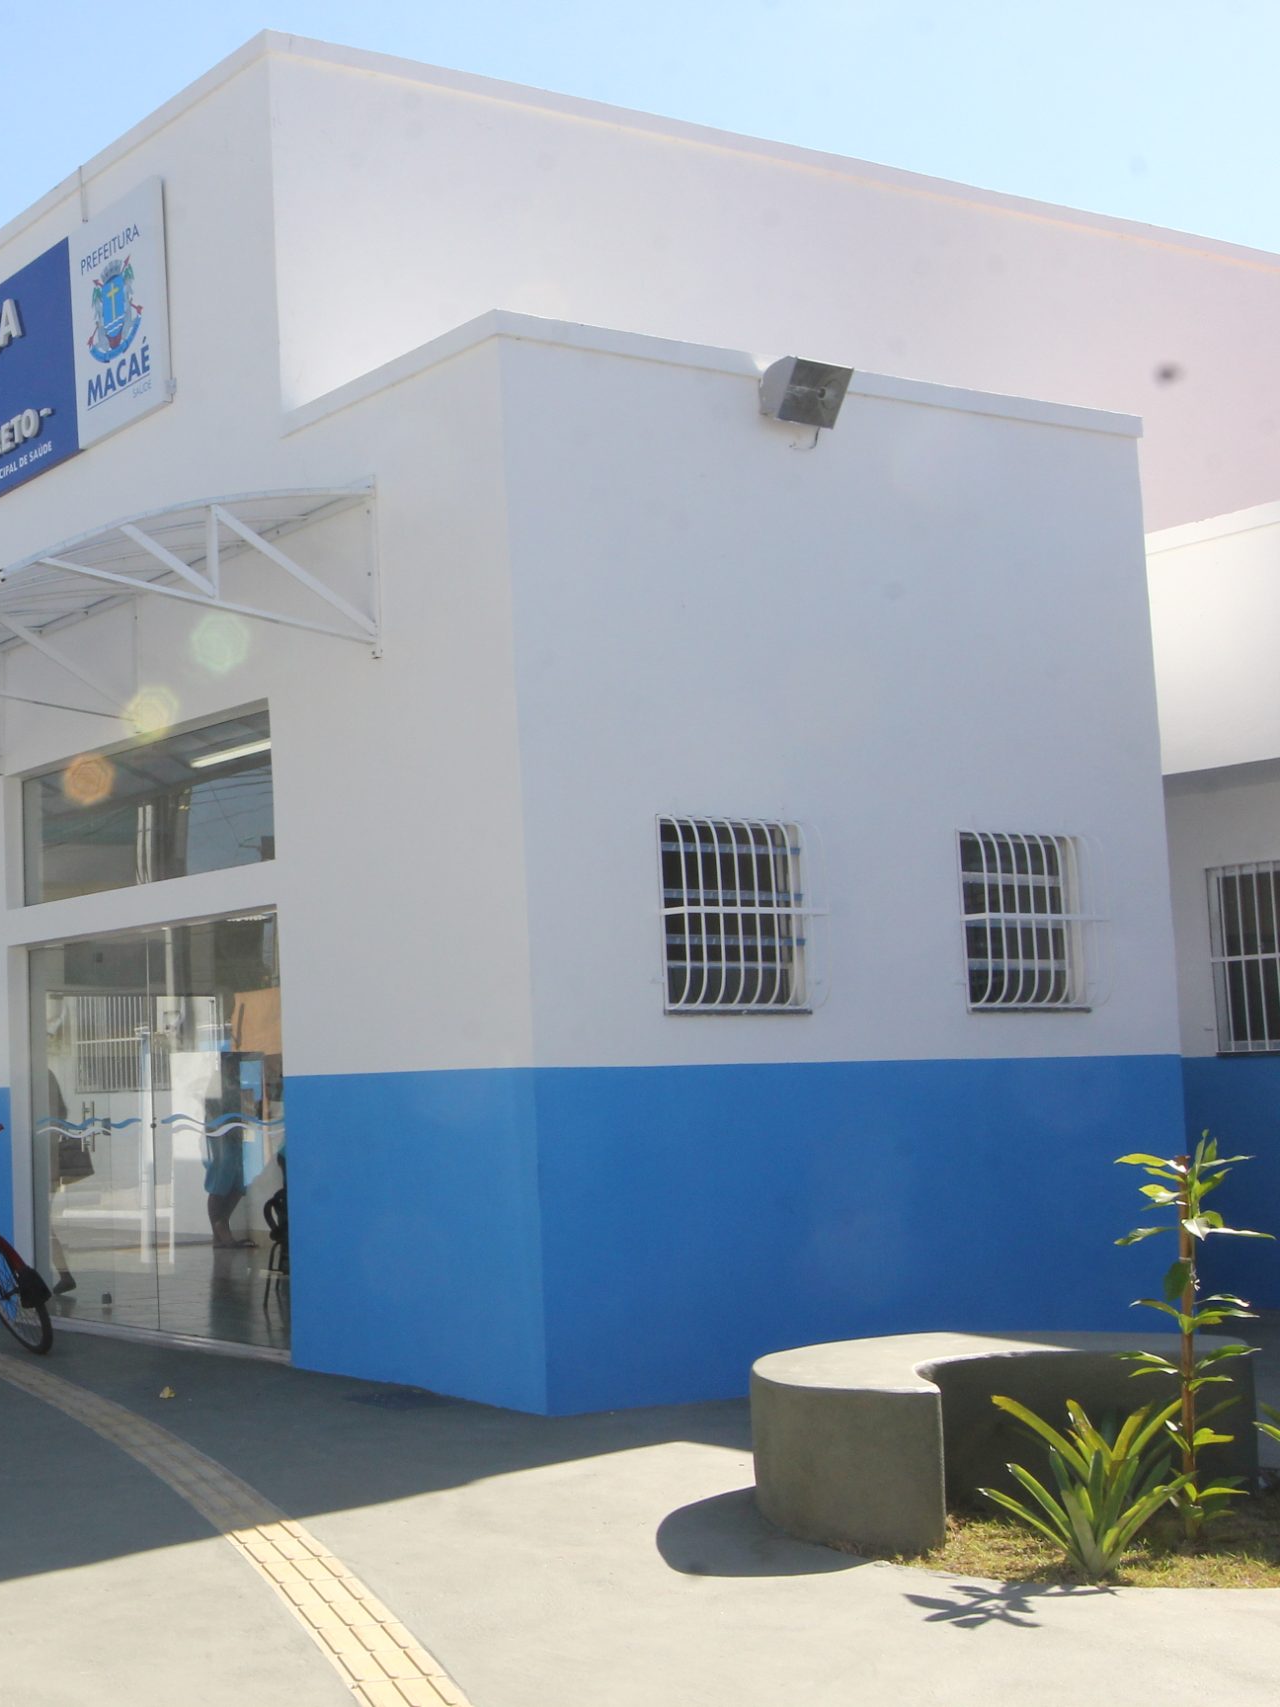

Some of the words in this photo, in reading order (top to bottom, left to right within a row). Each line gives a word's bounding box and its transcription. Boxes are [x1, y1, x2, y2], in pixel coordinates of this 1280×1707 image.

[80, 224, 140, 275] PREFEITURA
[87, 336, 151, 407] MACAÉ
[19, 454, 28, 469] DE
[29, 440, 53, 462] SAÚDE
